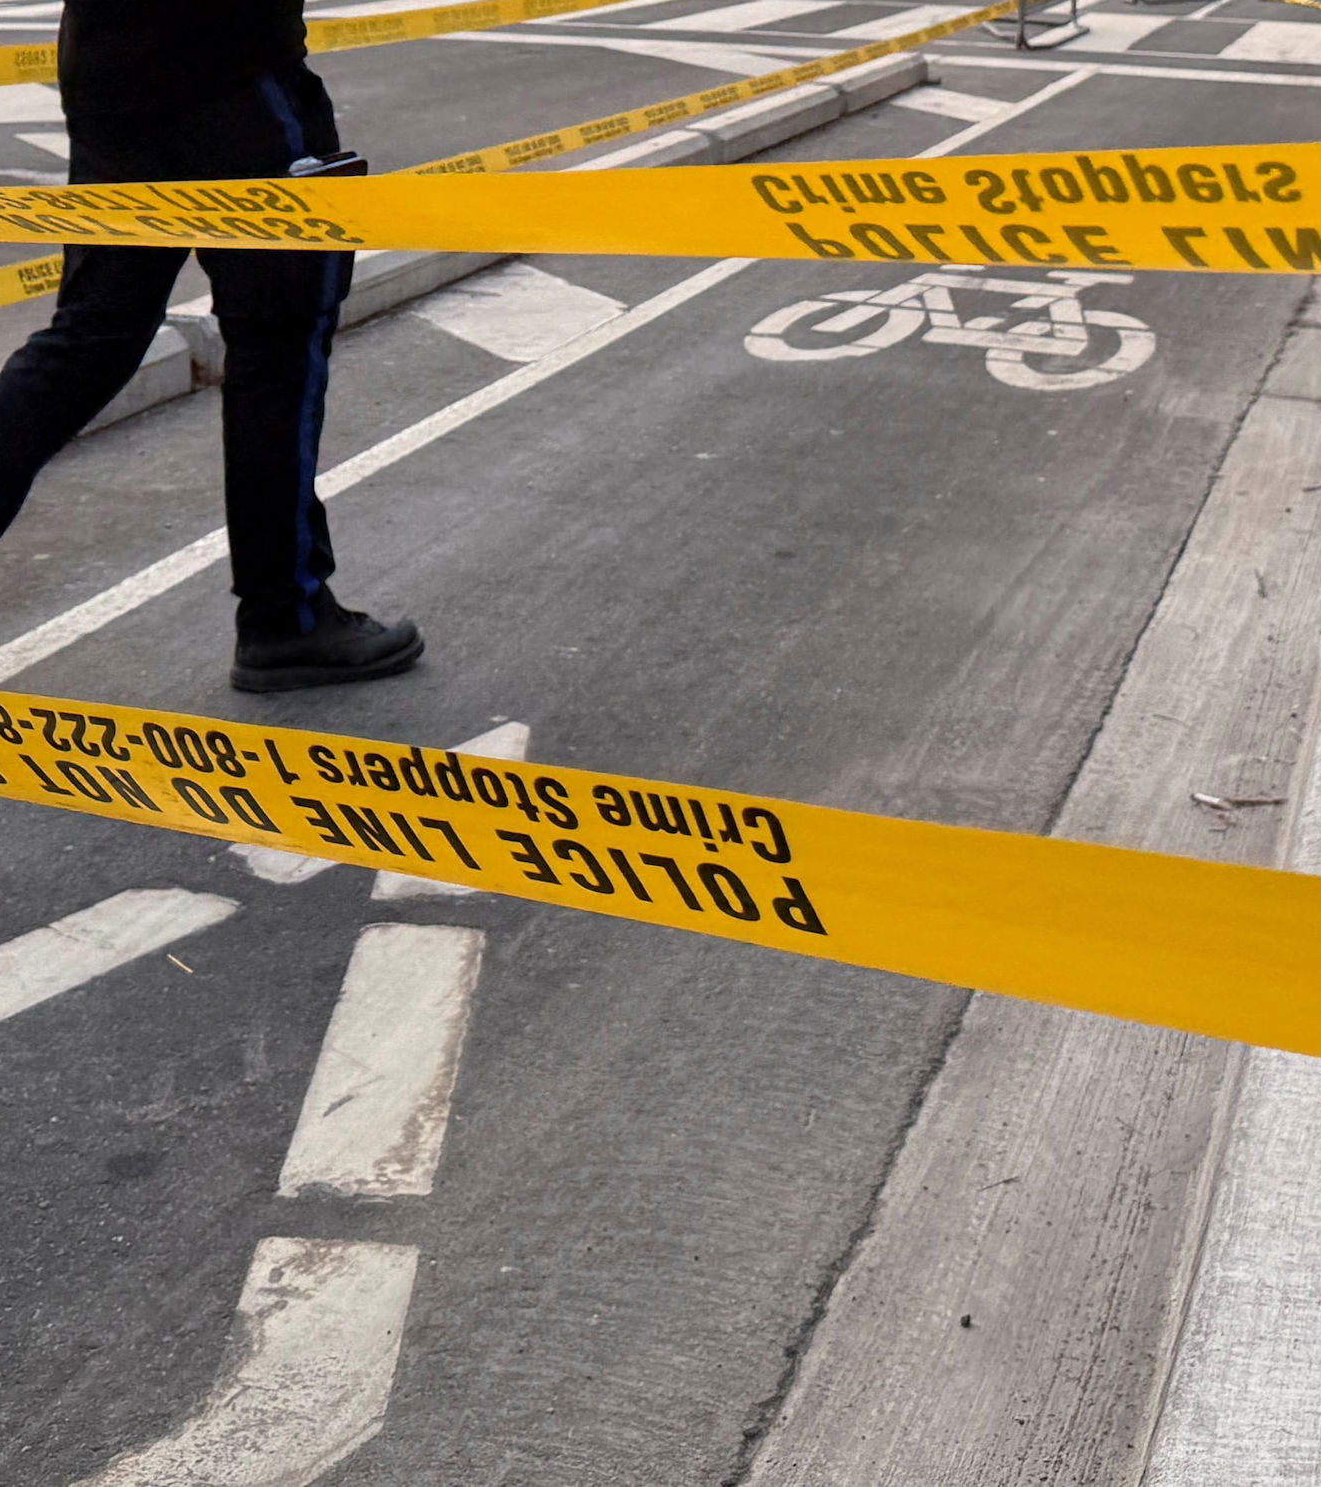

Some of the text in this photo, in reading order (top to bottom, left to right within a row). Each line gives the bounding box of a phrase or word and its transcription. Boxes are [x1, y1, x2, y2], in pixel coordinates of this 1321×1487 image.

[19, 753, 163, 813] NOT
[170, 777, 282, 834] DO
[309, 744, 578, 830] Stoppers
[290, 796, 481, 871] LINE
[592, 784, 792, 863] Crime
[495, 828, 828, 936] POLICE
